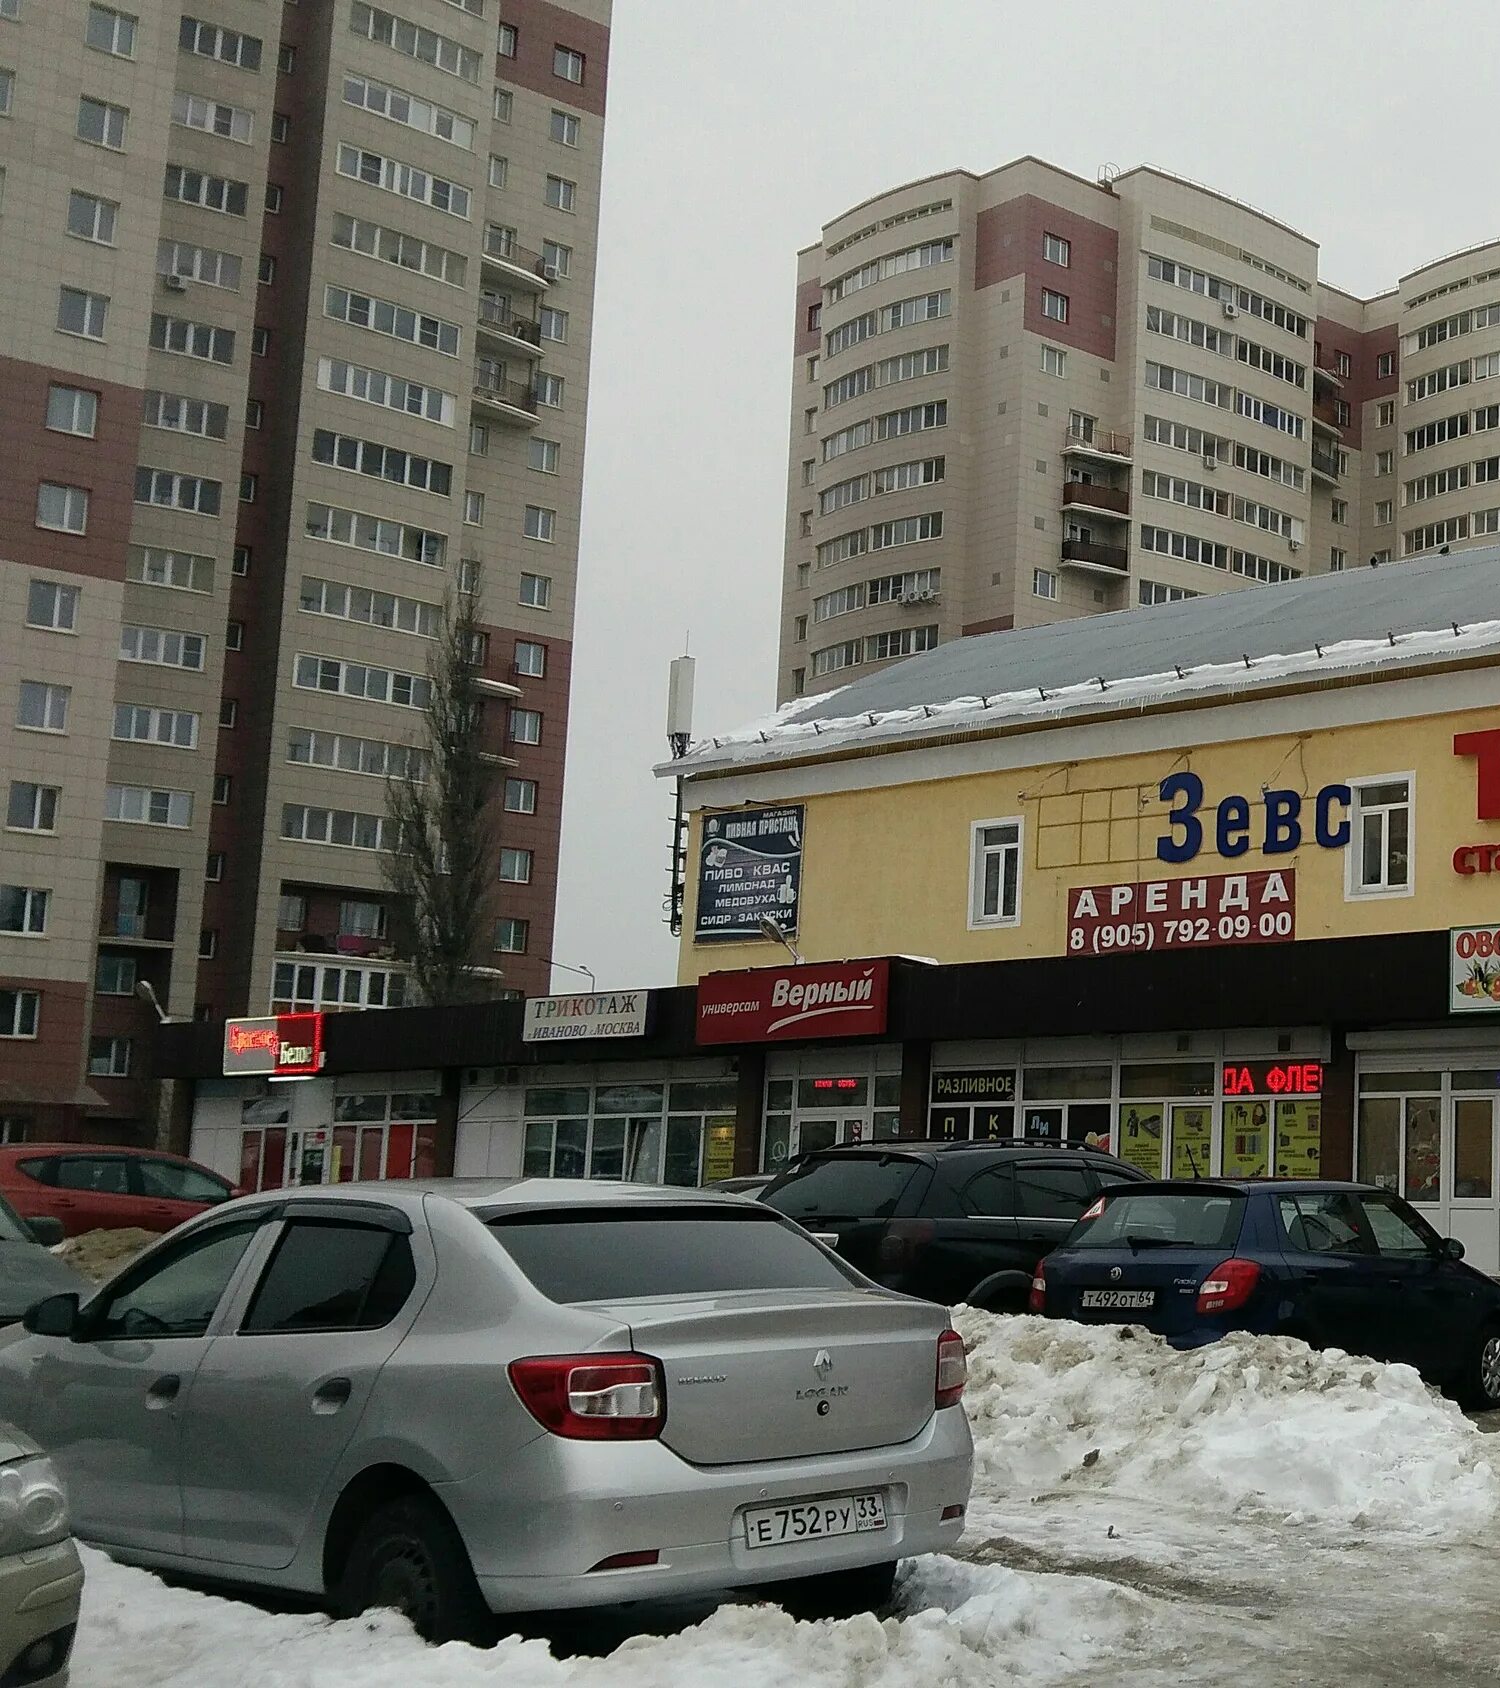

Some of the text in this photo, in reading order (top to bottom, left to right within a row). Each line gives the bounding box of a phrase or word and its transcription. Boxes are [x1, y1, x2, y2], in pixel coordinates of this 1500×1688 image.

[763, 809, 797, 818] МАГАЗИН
[1156, 771, 1351, 863] Зевс
[726, 816, 798, 839] ПИВНАЯ ПРИСТАНЬ
[705, 862, 790, 880] ПИВО КВАС
[718, 879, 776, 893] ЛИМОНАД
[1073, 872, 1290, 919] АРЕНДА
[715, 894, 777, 908] МЕДОВУХА
[701, 909, 792, 925] СИДР ЗАКУСКИ
[1070, 927, 1084, 950] 8
[1093, 922, 1155, 953] (905)
[701, 967, 875, 1018] универсам Верный
[535, 994, 638, 1019] ТРИКОТАЖ
[937, 1077, 1012, 1094] РАЗЛИВНОЕ
[757, 1496, 878, 1542] Е752РУ 33
[858, 1519, 873, 1527] RUS
